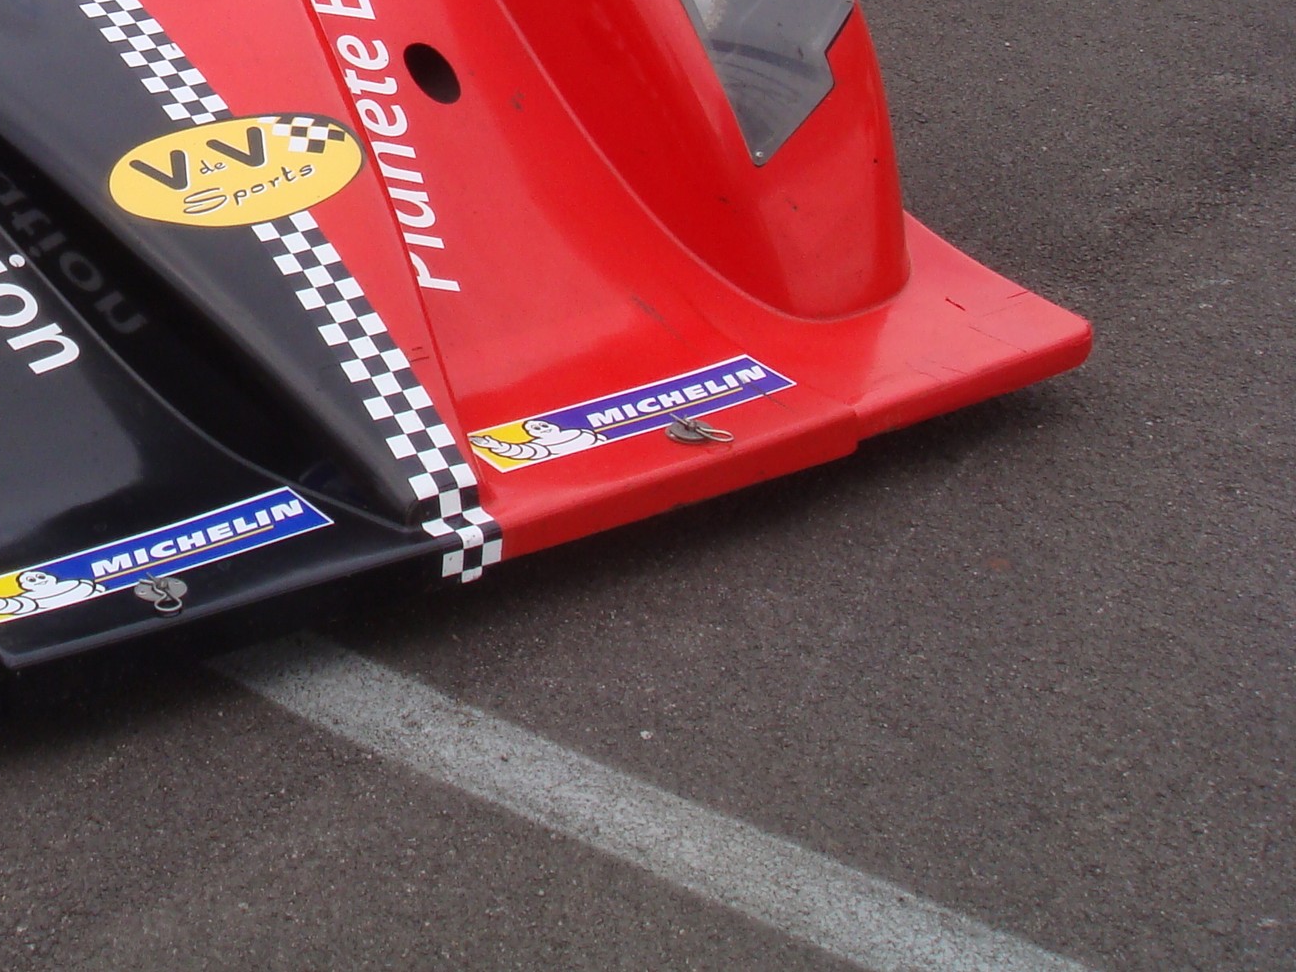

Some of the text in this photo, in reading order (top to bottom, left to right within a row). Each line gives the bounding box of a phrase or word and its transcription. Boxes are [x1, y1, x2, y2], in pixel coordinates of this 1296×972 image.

[129, 126, 266, 192] V de V
[183, 164, 315, 216] Sports
[586, 364, 767, 429] MICHELIN
[90, 499, 305, 578] MICHELIN
